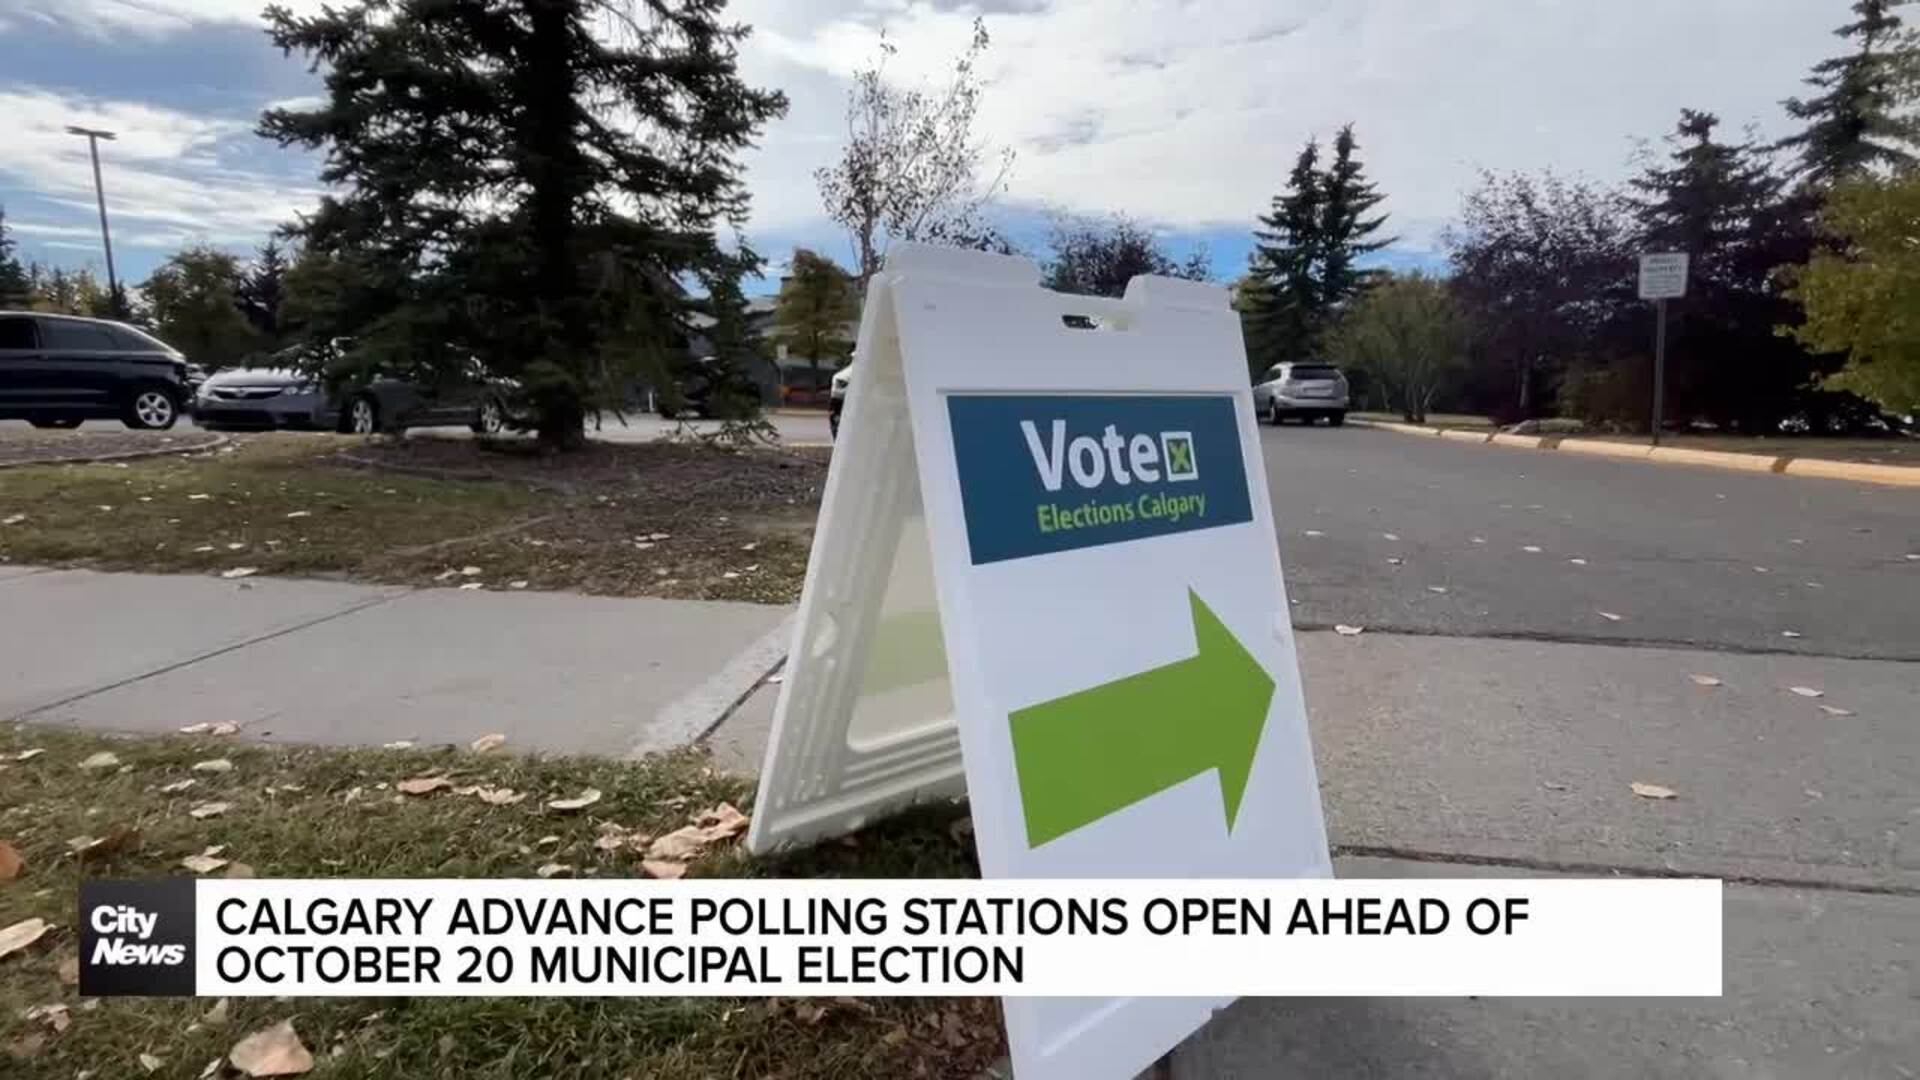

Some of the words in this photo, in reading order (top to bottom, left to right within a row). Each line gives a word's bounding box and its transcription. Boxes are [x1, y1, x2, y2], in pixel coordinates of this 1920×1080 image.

[1020, 419, 1161, 491] Vote
[1037, 499, 1134, 533] Elections
[1138, 492, 1206, 523] Calgary
